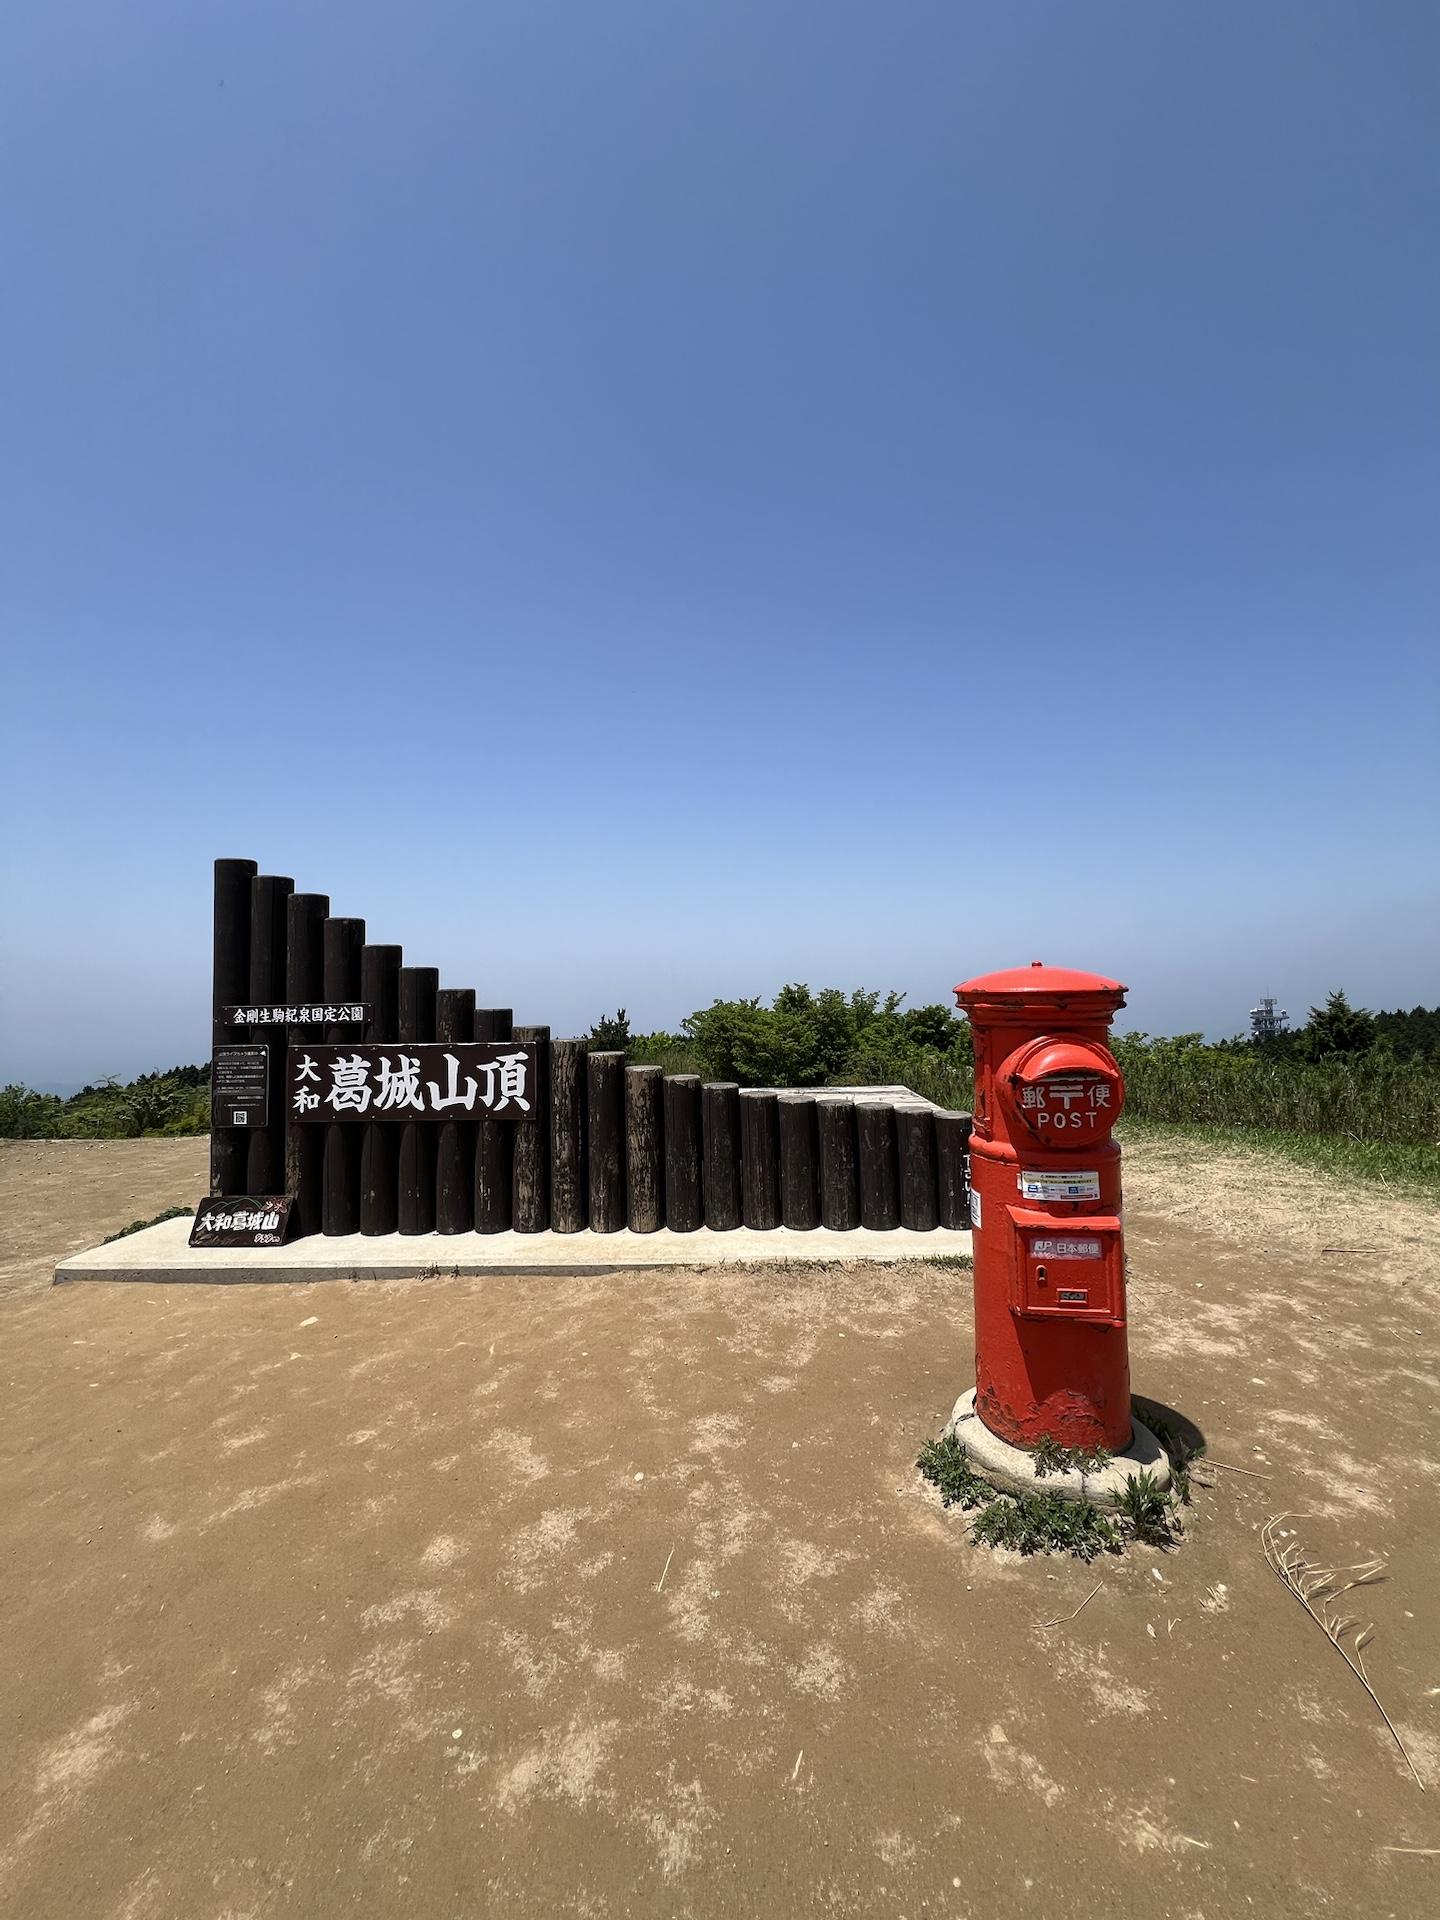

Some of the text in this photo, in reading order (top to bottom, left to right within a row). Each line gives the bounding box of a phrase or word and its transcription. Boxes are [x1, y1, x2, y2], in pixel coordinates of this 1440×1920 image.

[233, 1006, 364, 1024] 金剛生駒紀泉国定公園
[293, 1054, 322, 1114] 大和
[324, 1051, 531, 1113] 葛城山頂
[1037, 1111, 1097, 1129] POST
[195, 1210, 280, 1232] 大和葛城山
[1056, 1242, 1100, 1254] 日本郵便
